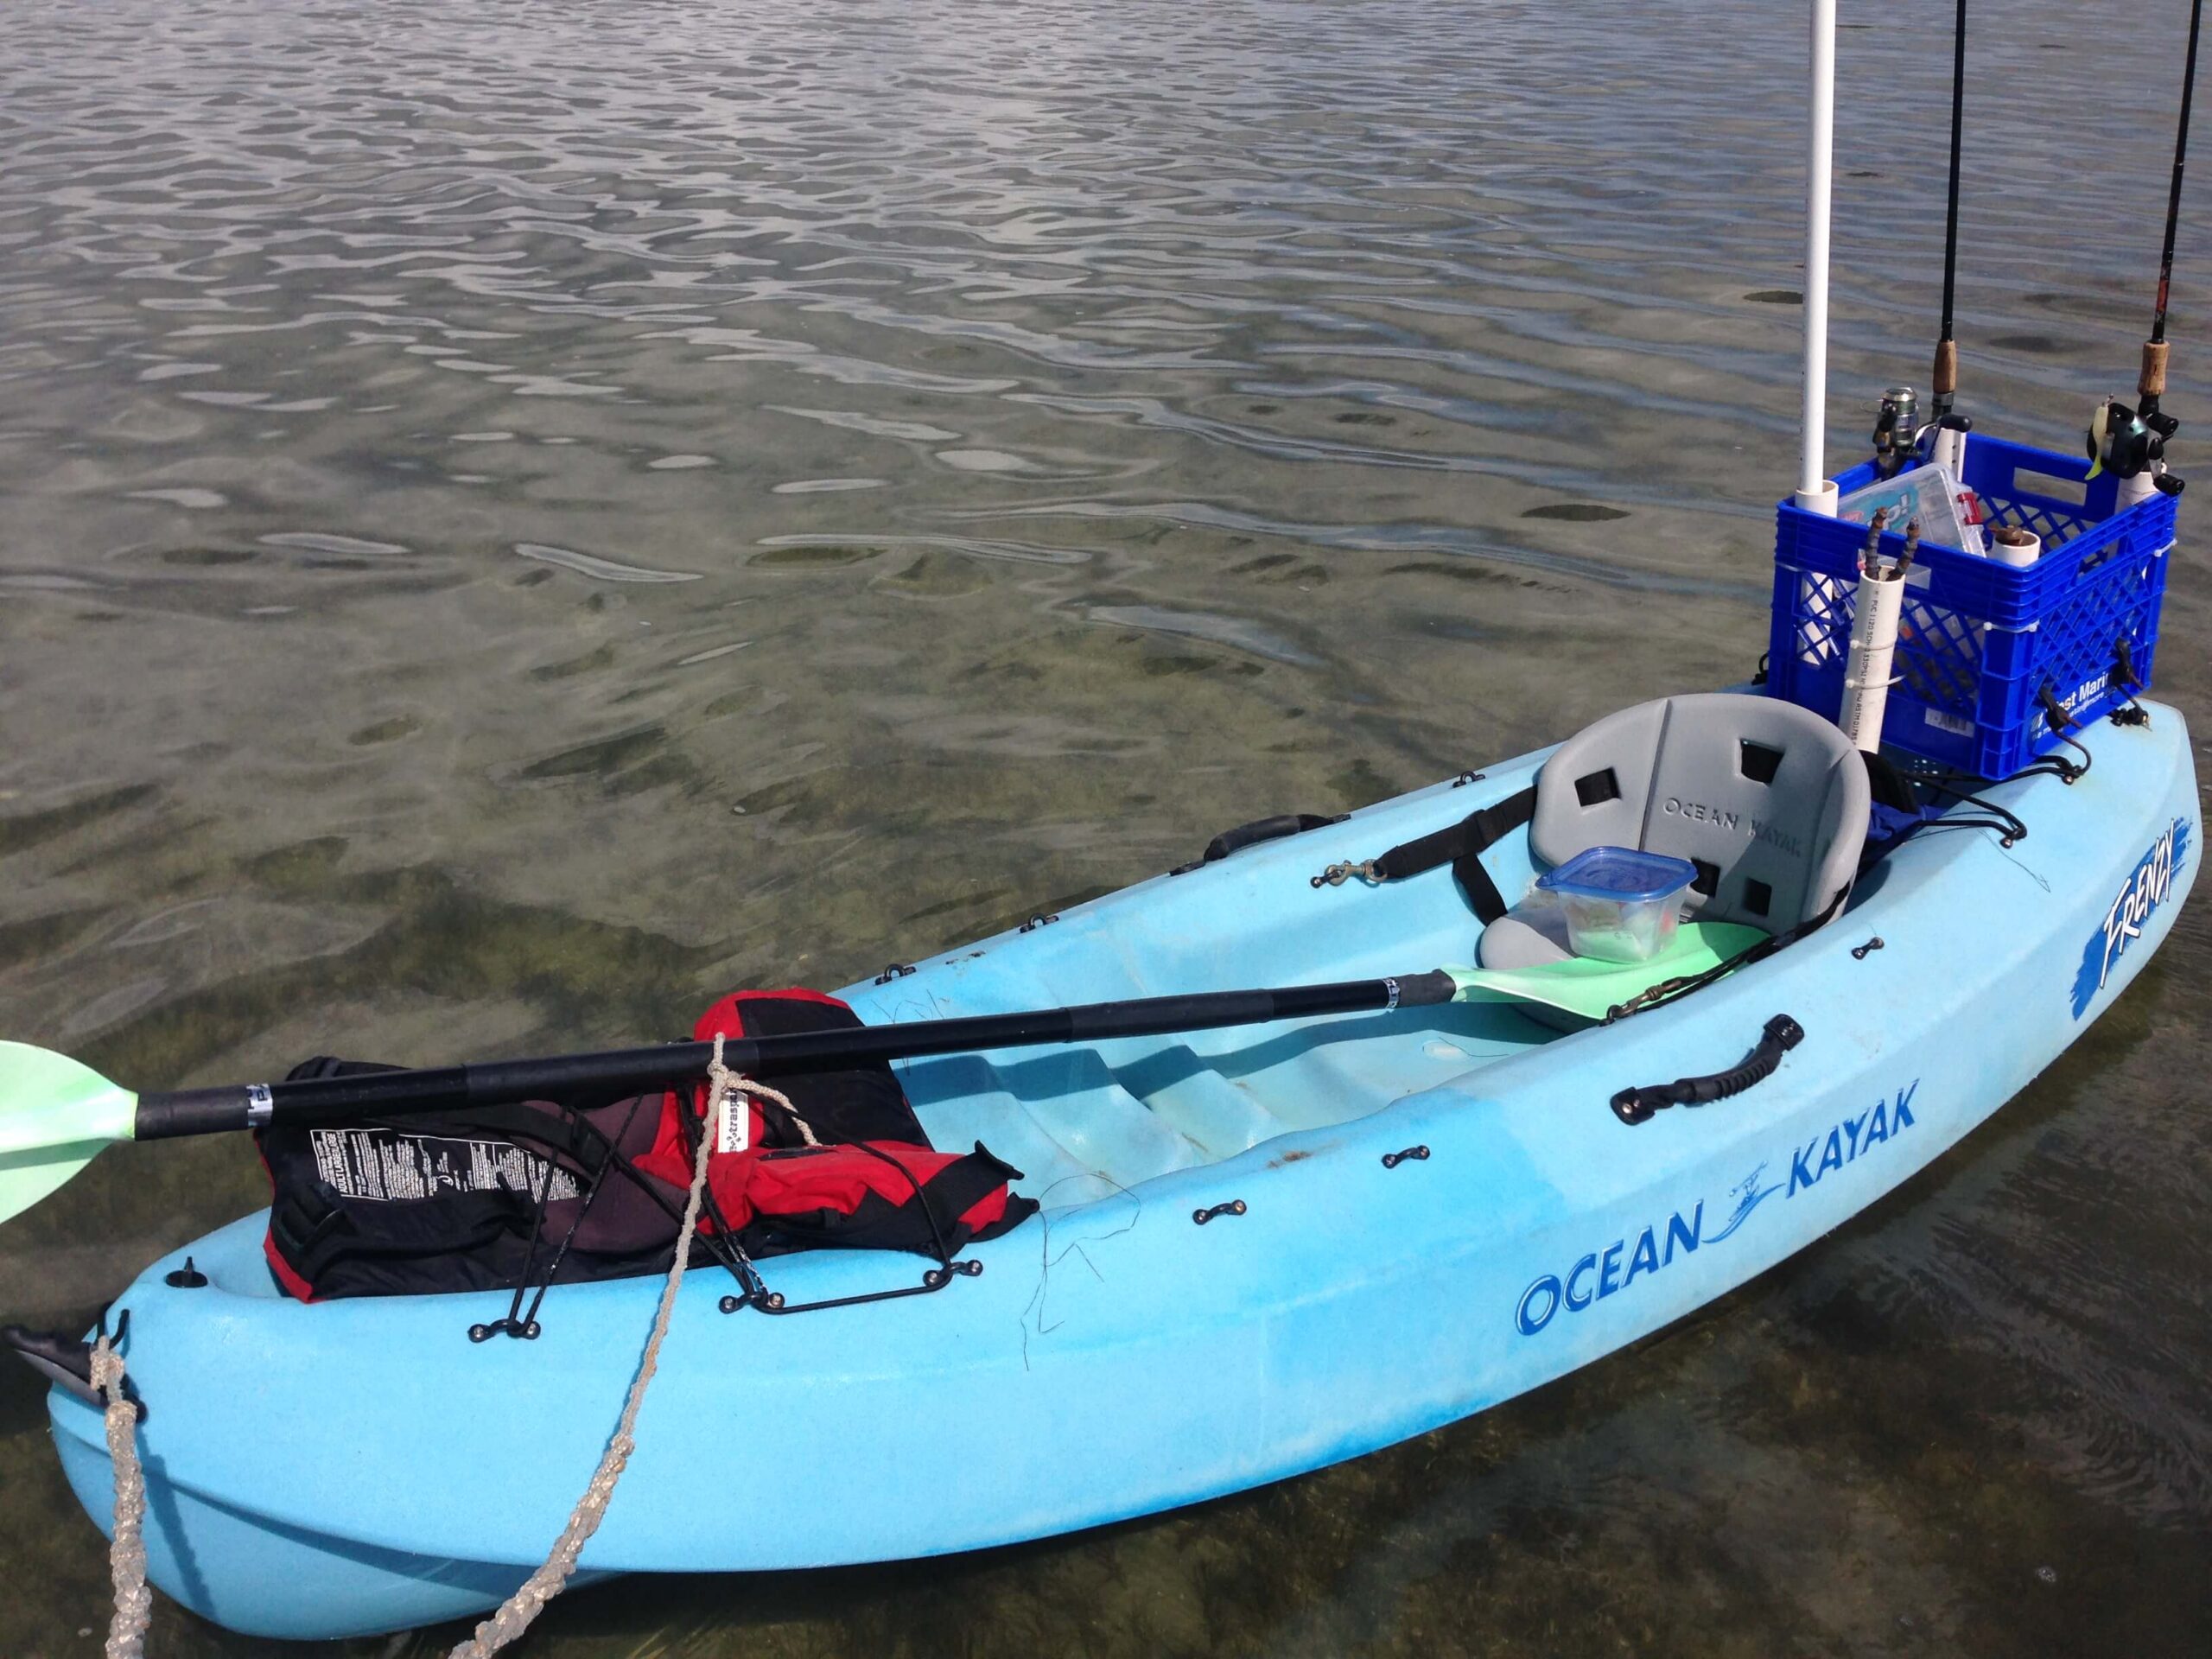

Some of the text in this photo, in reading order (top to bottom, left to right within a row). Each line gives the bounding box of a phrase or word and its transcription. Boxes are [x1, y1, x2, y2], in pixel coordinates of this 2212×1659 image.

[1662, 797, 1739, 830] OCEAN
[2099, 817, 2175, 989] FRENZY
[1515, 1077, 1920, 1337] OCEAN KAYAK
